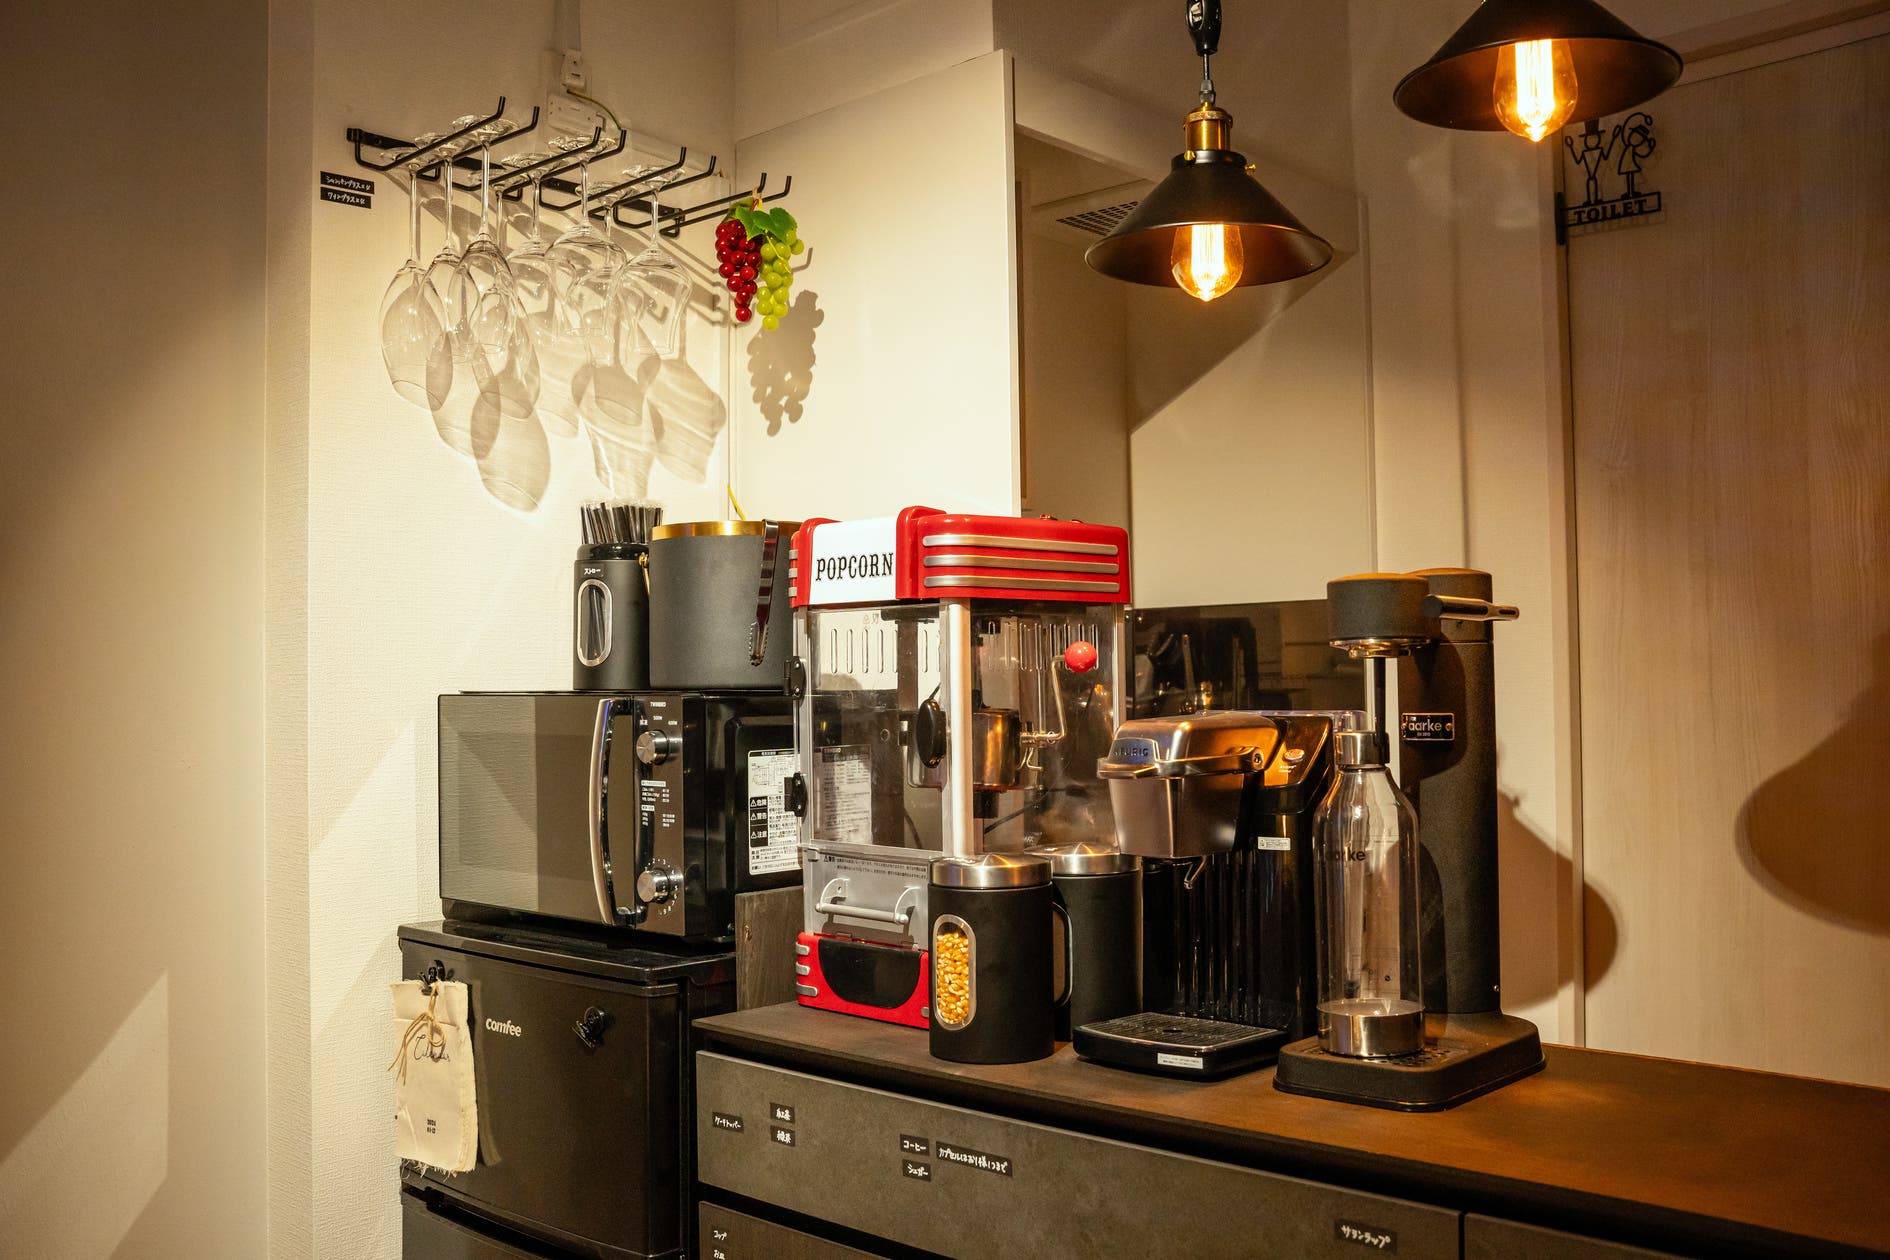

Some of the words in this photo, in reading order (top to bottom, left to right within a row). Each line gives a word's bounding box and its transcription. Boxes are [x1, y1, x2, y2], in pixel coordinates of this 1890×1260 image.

[1574, 199, 1647, 224] TOILET
[815, 552, 894, 582] POPCORN
[1408, 718, 1443, 731] aarke
[485, 1018, 523, 1038] comfee
[902, 1140, 927, 1152] コーヒー
[906, 1163, 929, 1177] シュガー
